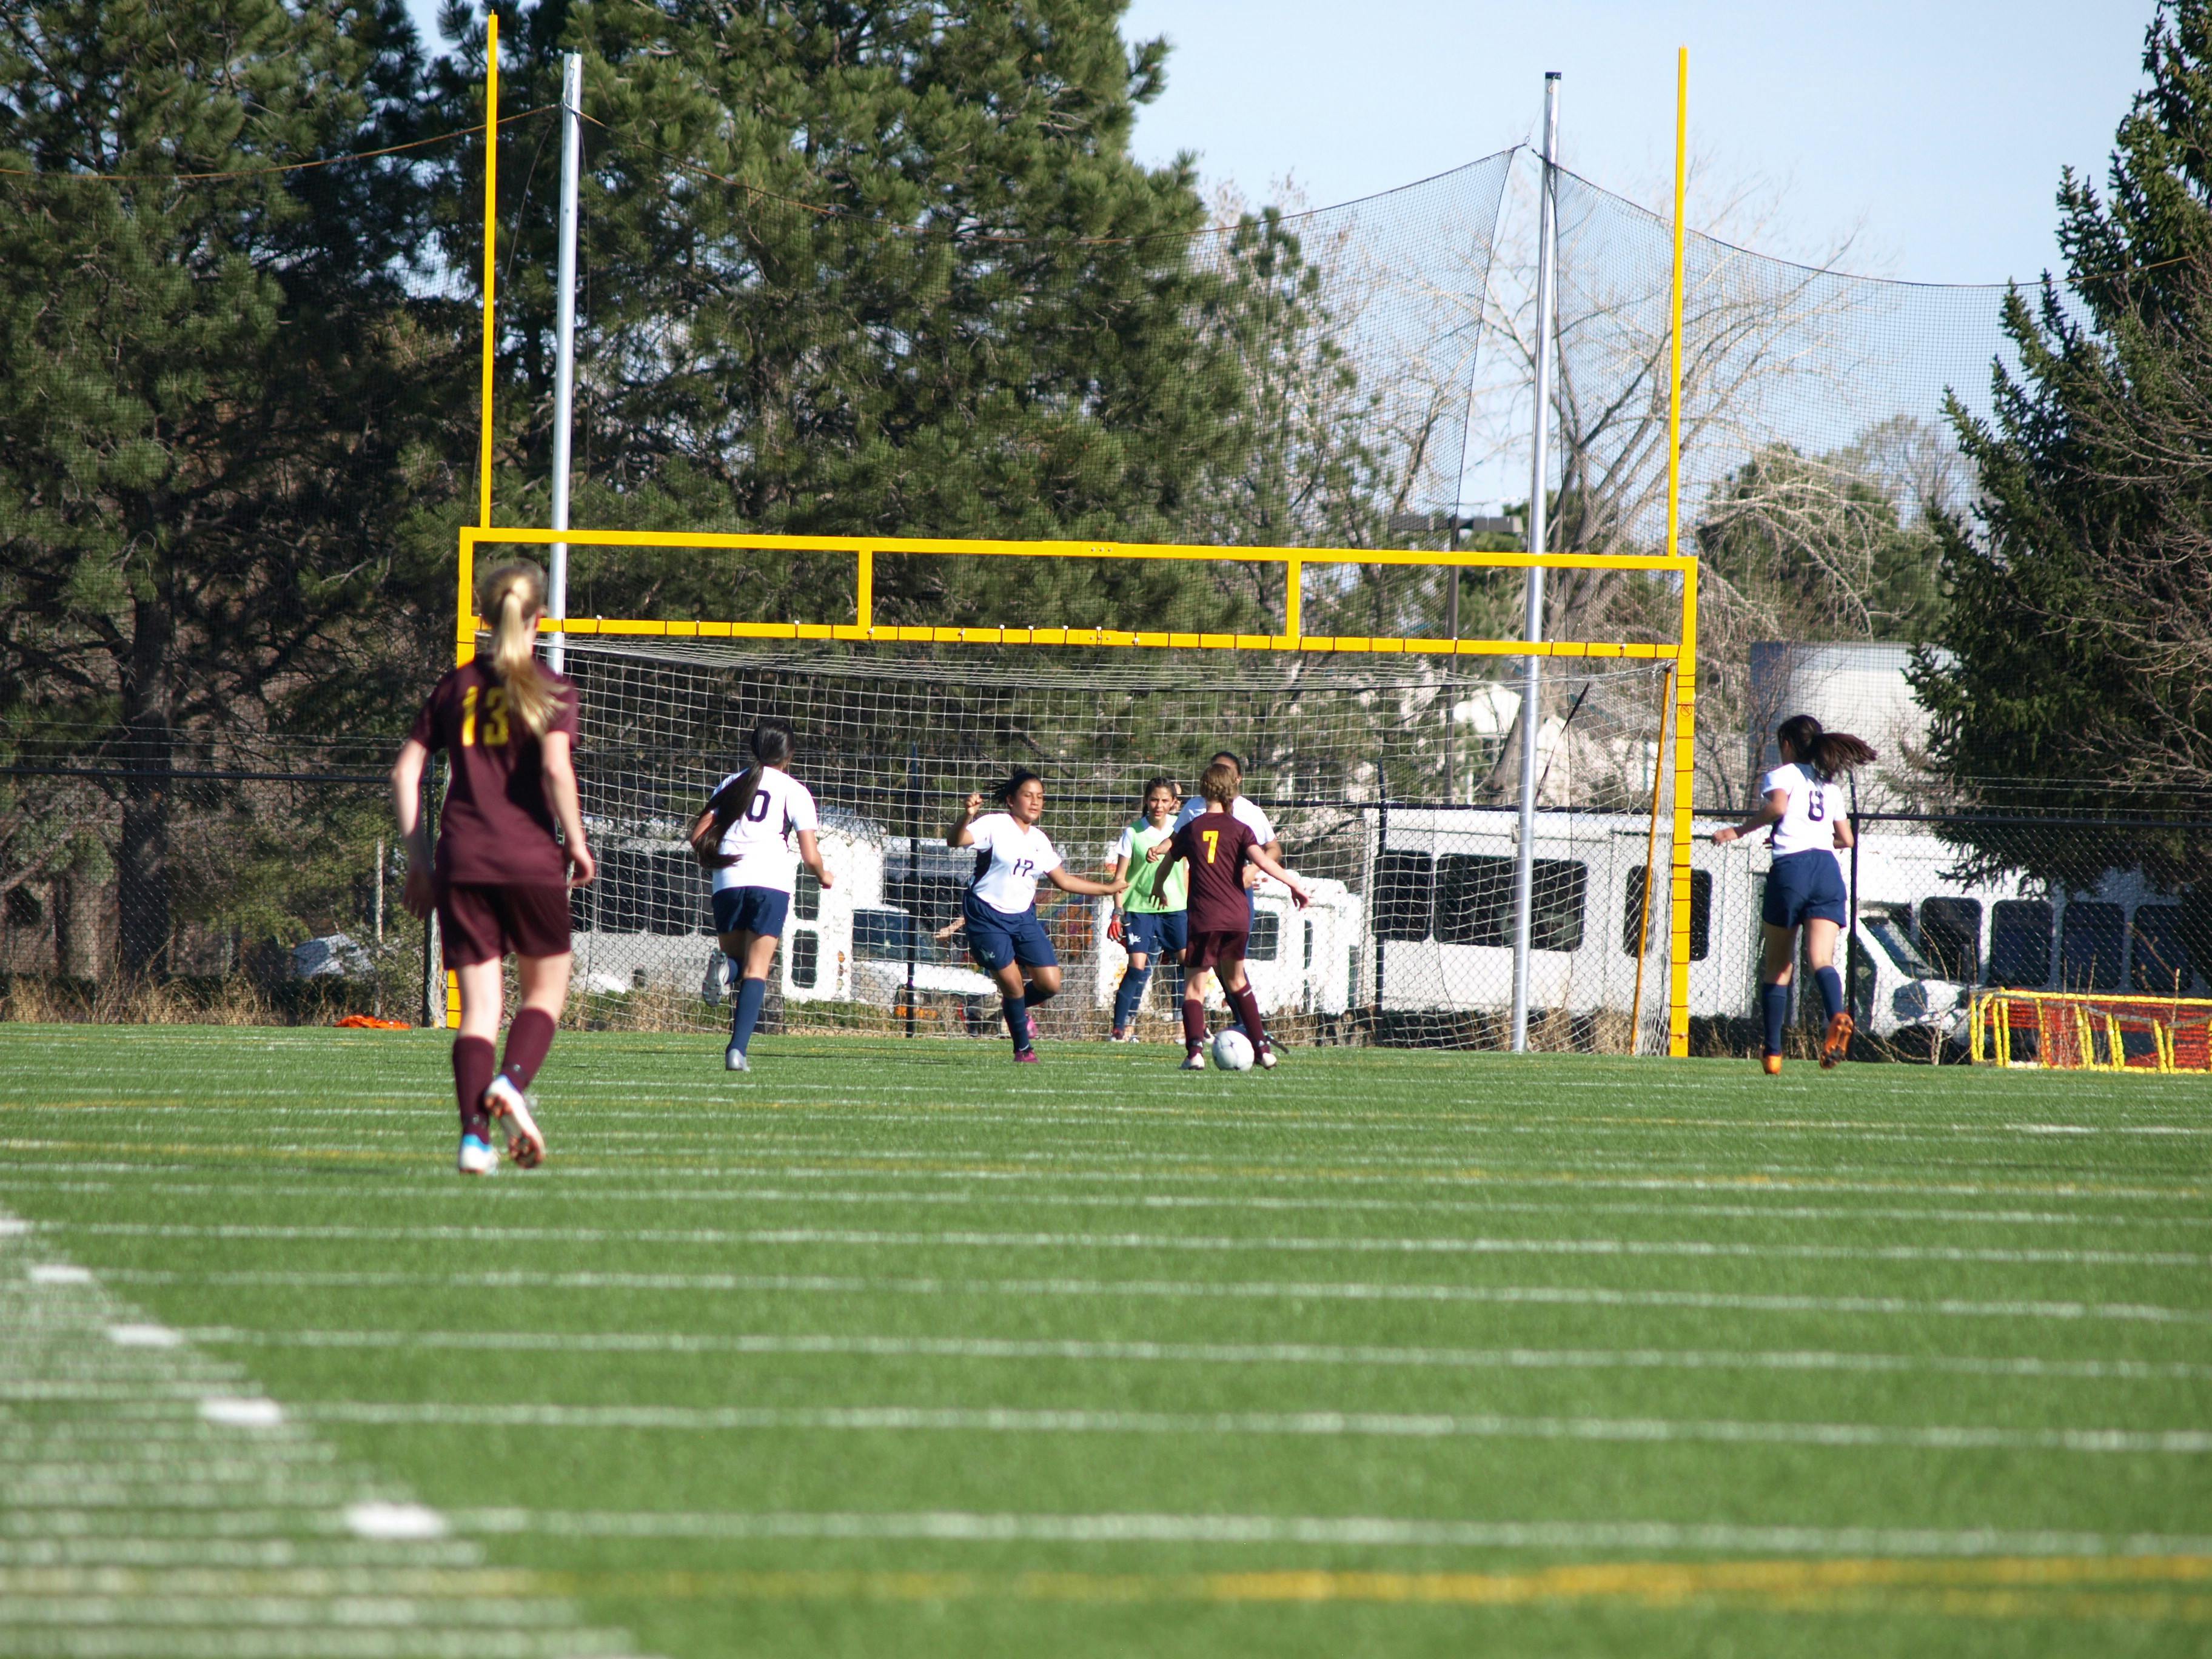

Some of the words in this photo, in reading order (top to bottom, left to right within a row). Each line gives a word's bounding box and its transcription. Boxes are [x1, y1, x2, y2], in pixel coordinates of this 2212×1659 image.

[462, 685, 509, 746] 13
[1808, 790, 1825, 822] 8
[1202, 831, 1219, 863] 7
